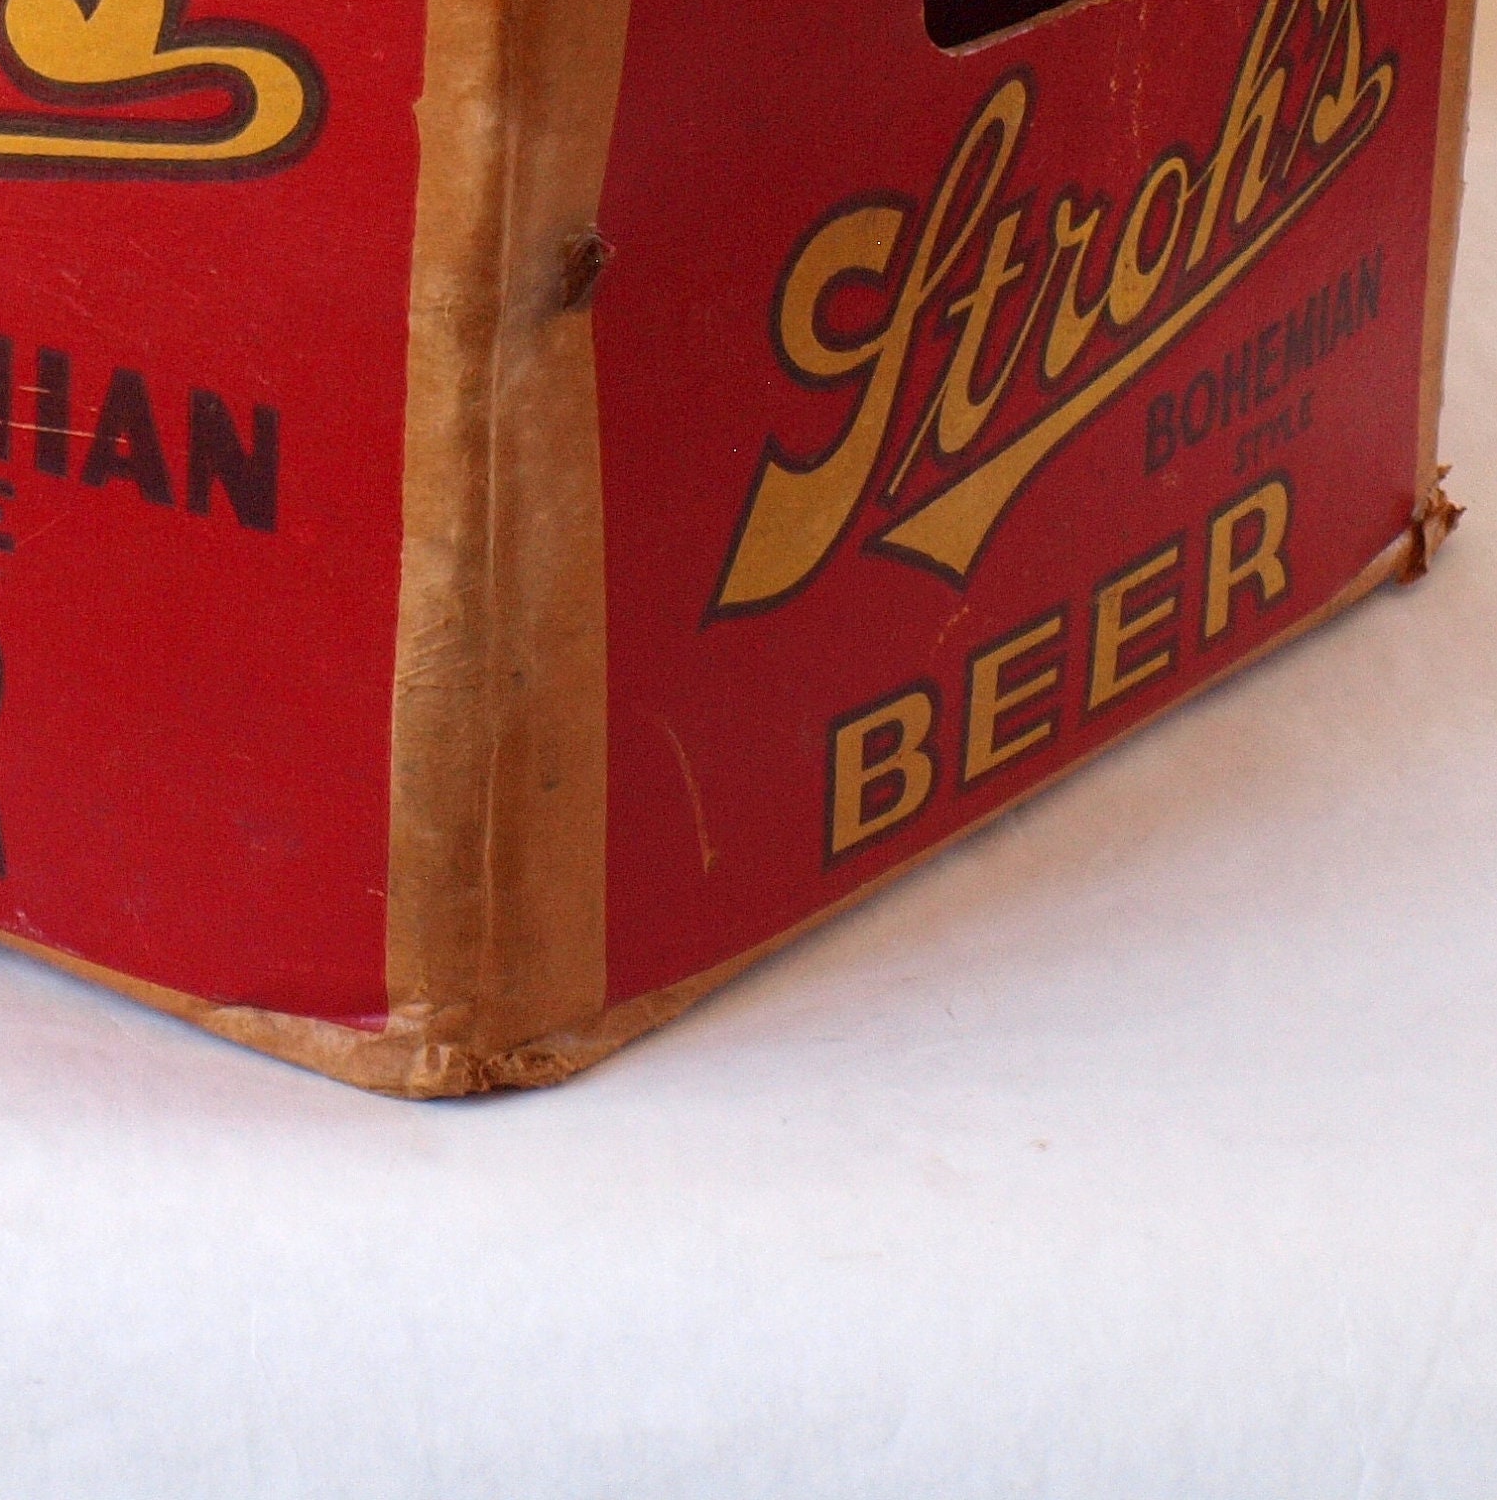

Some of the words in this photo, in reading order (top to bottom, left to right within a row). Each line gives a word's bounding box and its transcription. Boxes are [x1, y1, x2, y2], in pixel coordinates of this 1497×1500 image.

[1143, 249, 1386, 475] BOHEMIAN
[1231, 392, 1317, 477] STYLE
[821, 468, 1296, 873] BEER
